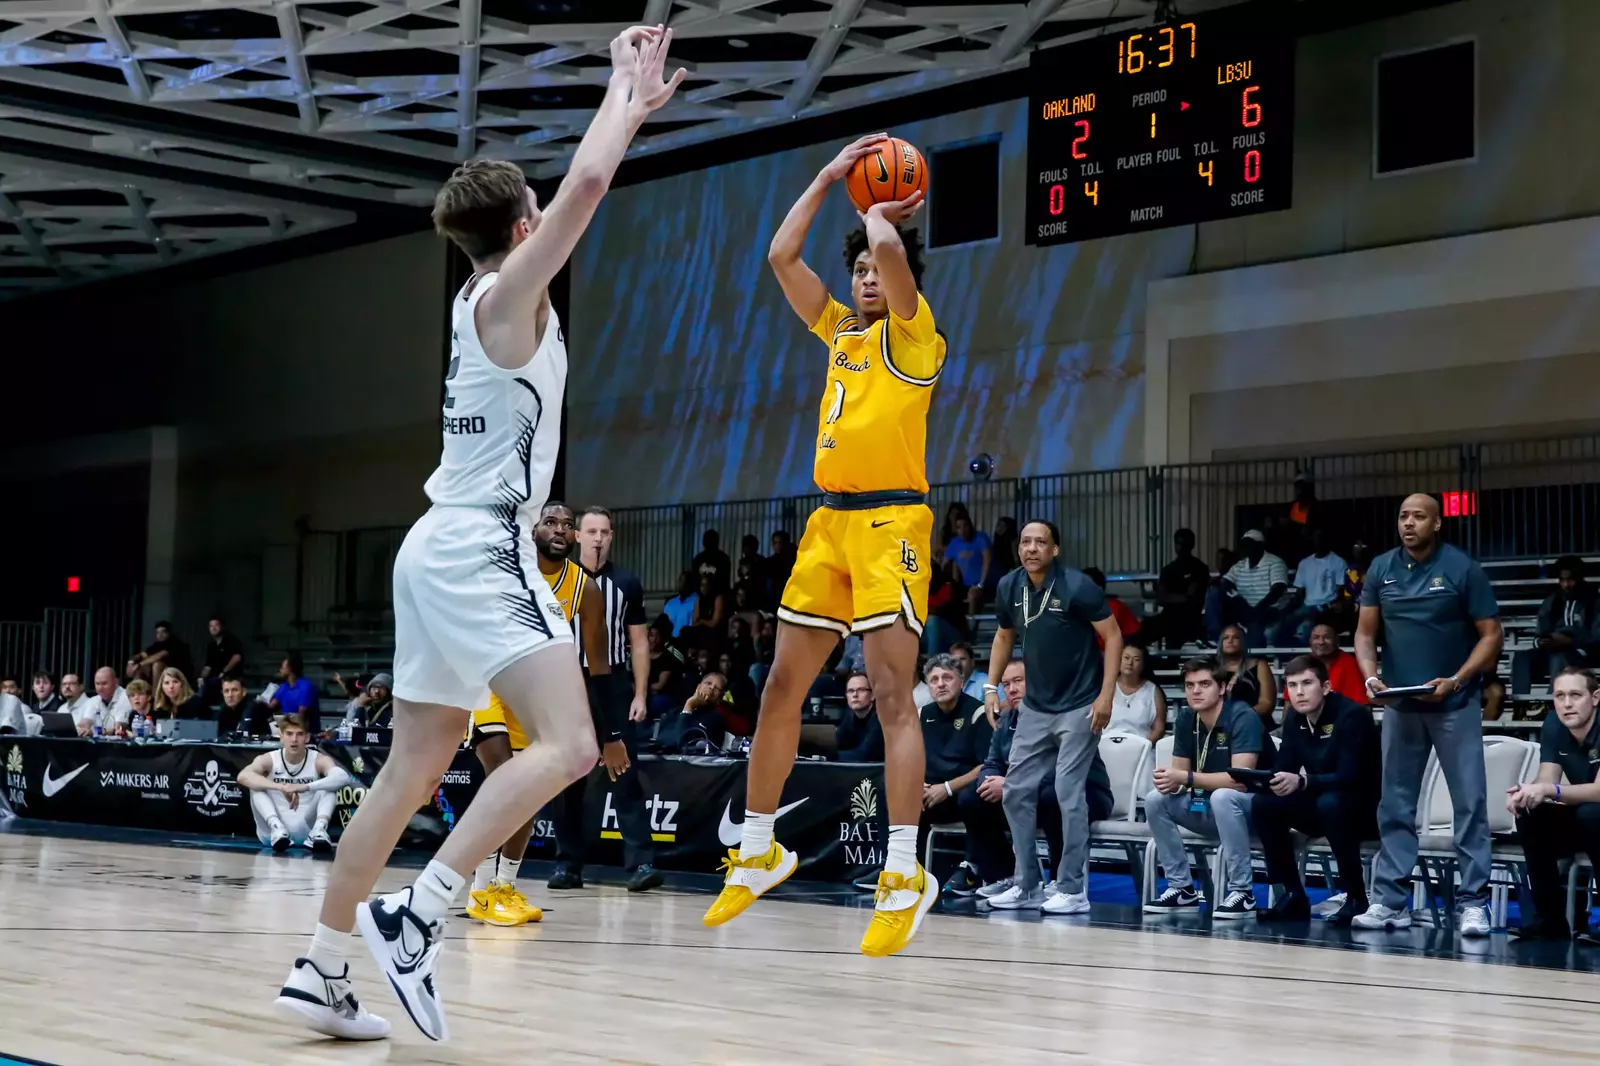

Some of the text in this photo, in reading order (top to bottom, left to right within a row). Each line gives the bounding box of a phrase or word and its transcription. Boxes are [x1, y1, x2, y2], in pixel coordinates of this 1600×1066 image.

[1118, 23, 1197, 74] 16:37
[1217, 60, 1252, 85] LBSU
[1043, 93, 1096, 120] OAKLAND
[1132, 89, 1167, 108] PERIOD
[1241, 85, 1261, 128] 6
[1150, 112, 1156, 139] 1
[1071, 119, 1090, 160] 2
[1193, 140, 1219, 157] T.O.L.
[1232, 131, 1266, 149] FOULS
[901, 144, 916, 185] ELITE
[1080, 161, 1104, 177] T.O.L.
[1117, 147, 1182, 170] PLAYER FOUL
[1244, 150, 1261, 183] 0
[1039, 167, 1068, 184] FOULS
[1198, 160, 1214, 186] 4
[1049, 184, 1065, 215] 0
[1084, 180, 1099, 206] 4
[1231, 189, 1265, 207] SCORE
[1130, 205, 1164, 222] MATCH
[1038, 221, 1068, 237] SCORE
[835, 351, 871, 373] Beach
[115, 772, 170, 789] MAKERS AIR
[601, 791, 680, 832] htz
[844, 845, 884, 865] MA
